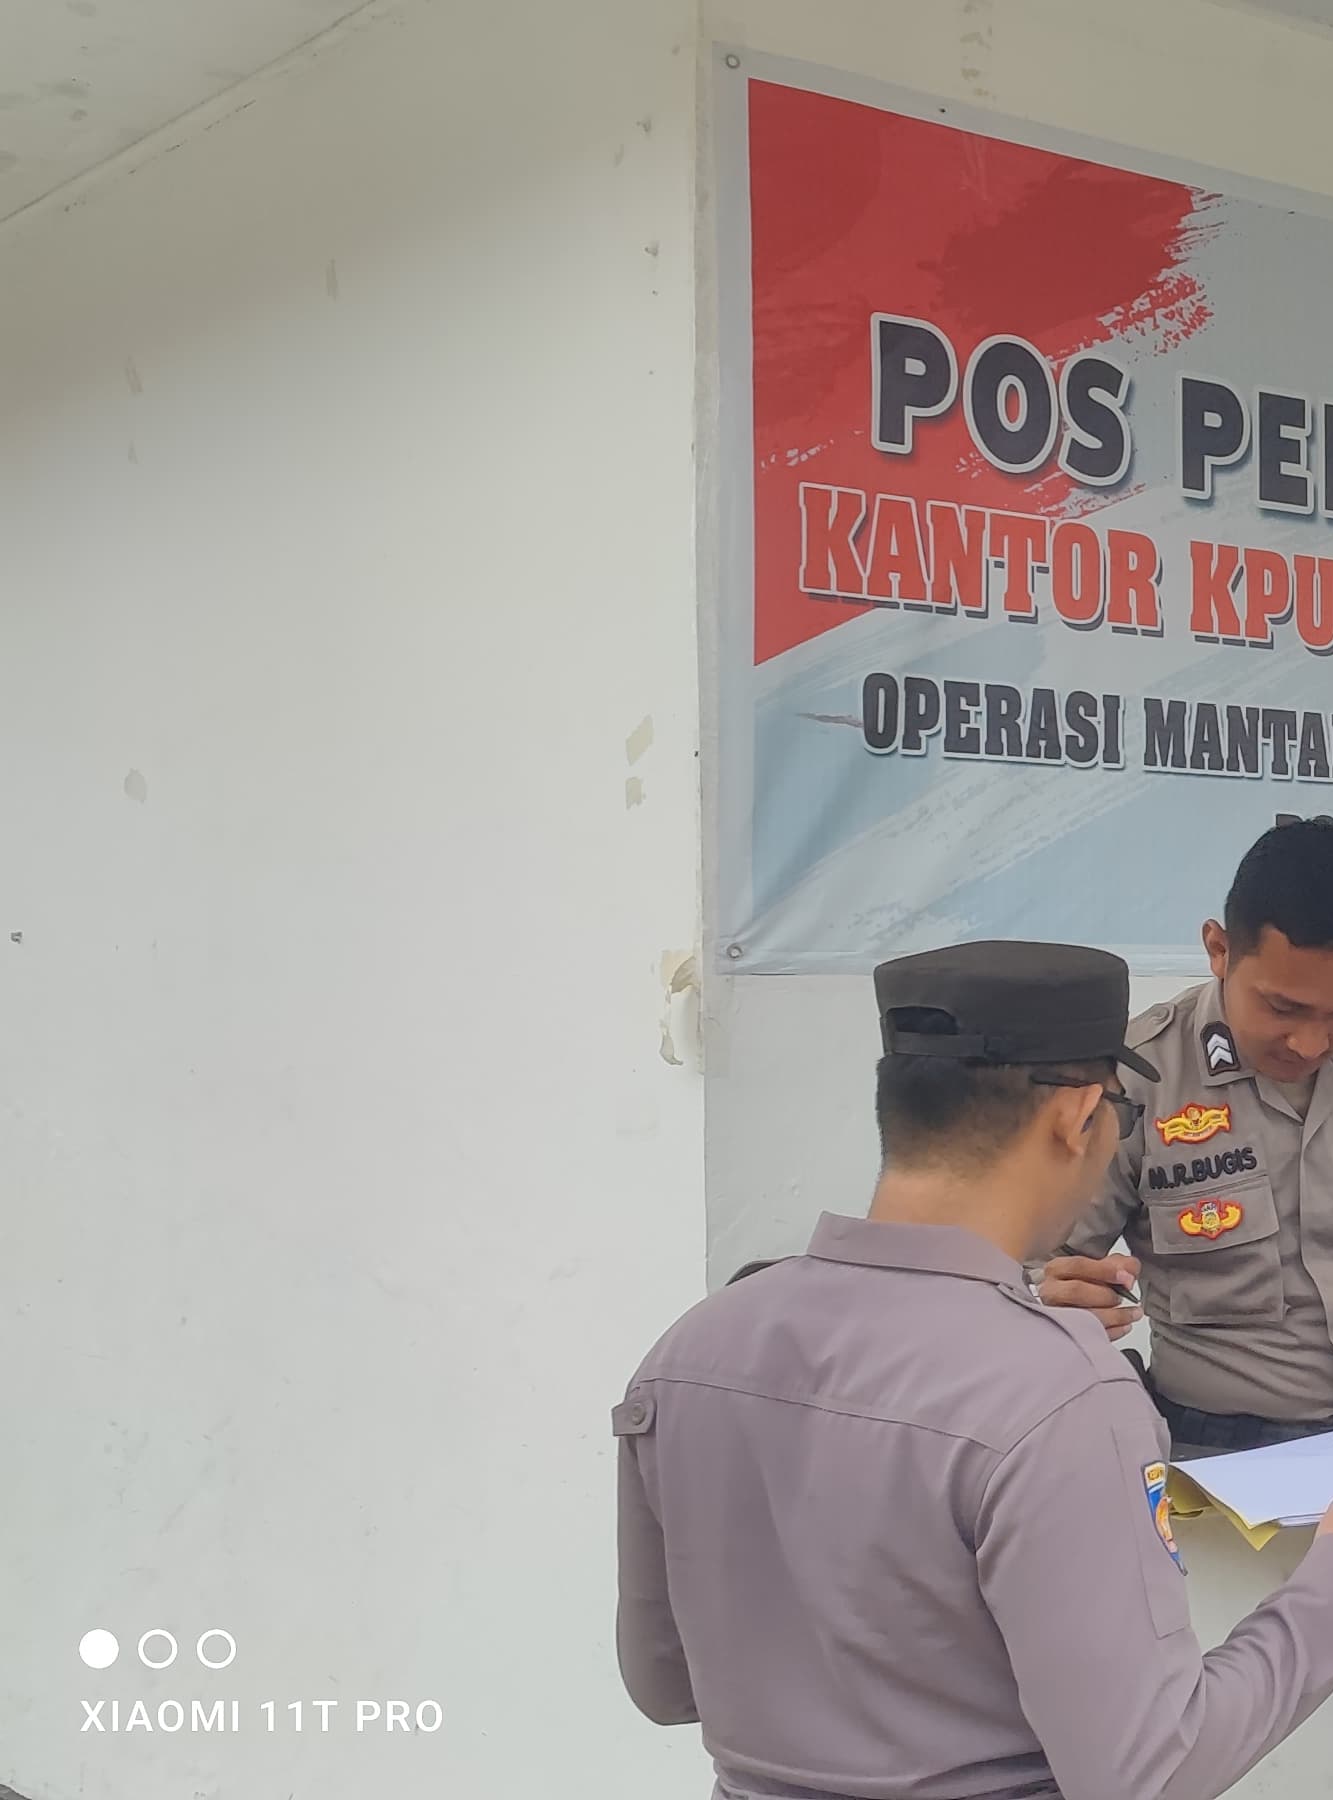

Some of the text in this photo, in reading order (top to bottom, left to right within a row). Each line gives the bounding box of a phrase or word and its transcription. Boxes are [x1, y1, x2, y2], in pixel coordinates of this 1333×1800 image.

[873, 316, 1132, 484] POS
[800, 485, 1162, 634] KANTOR
[862, 673, 1125, 769] OPERASI
